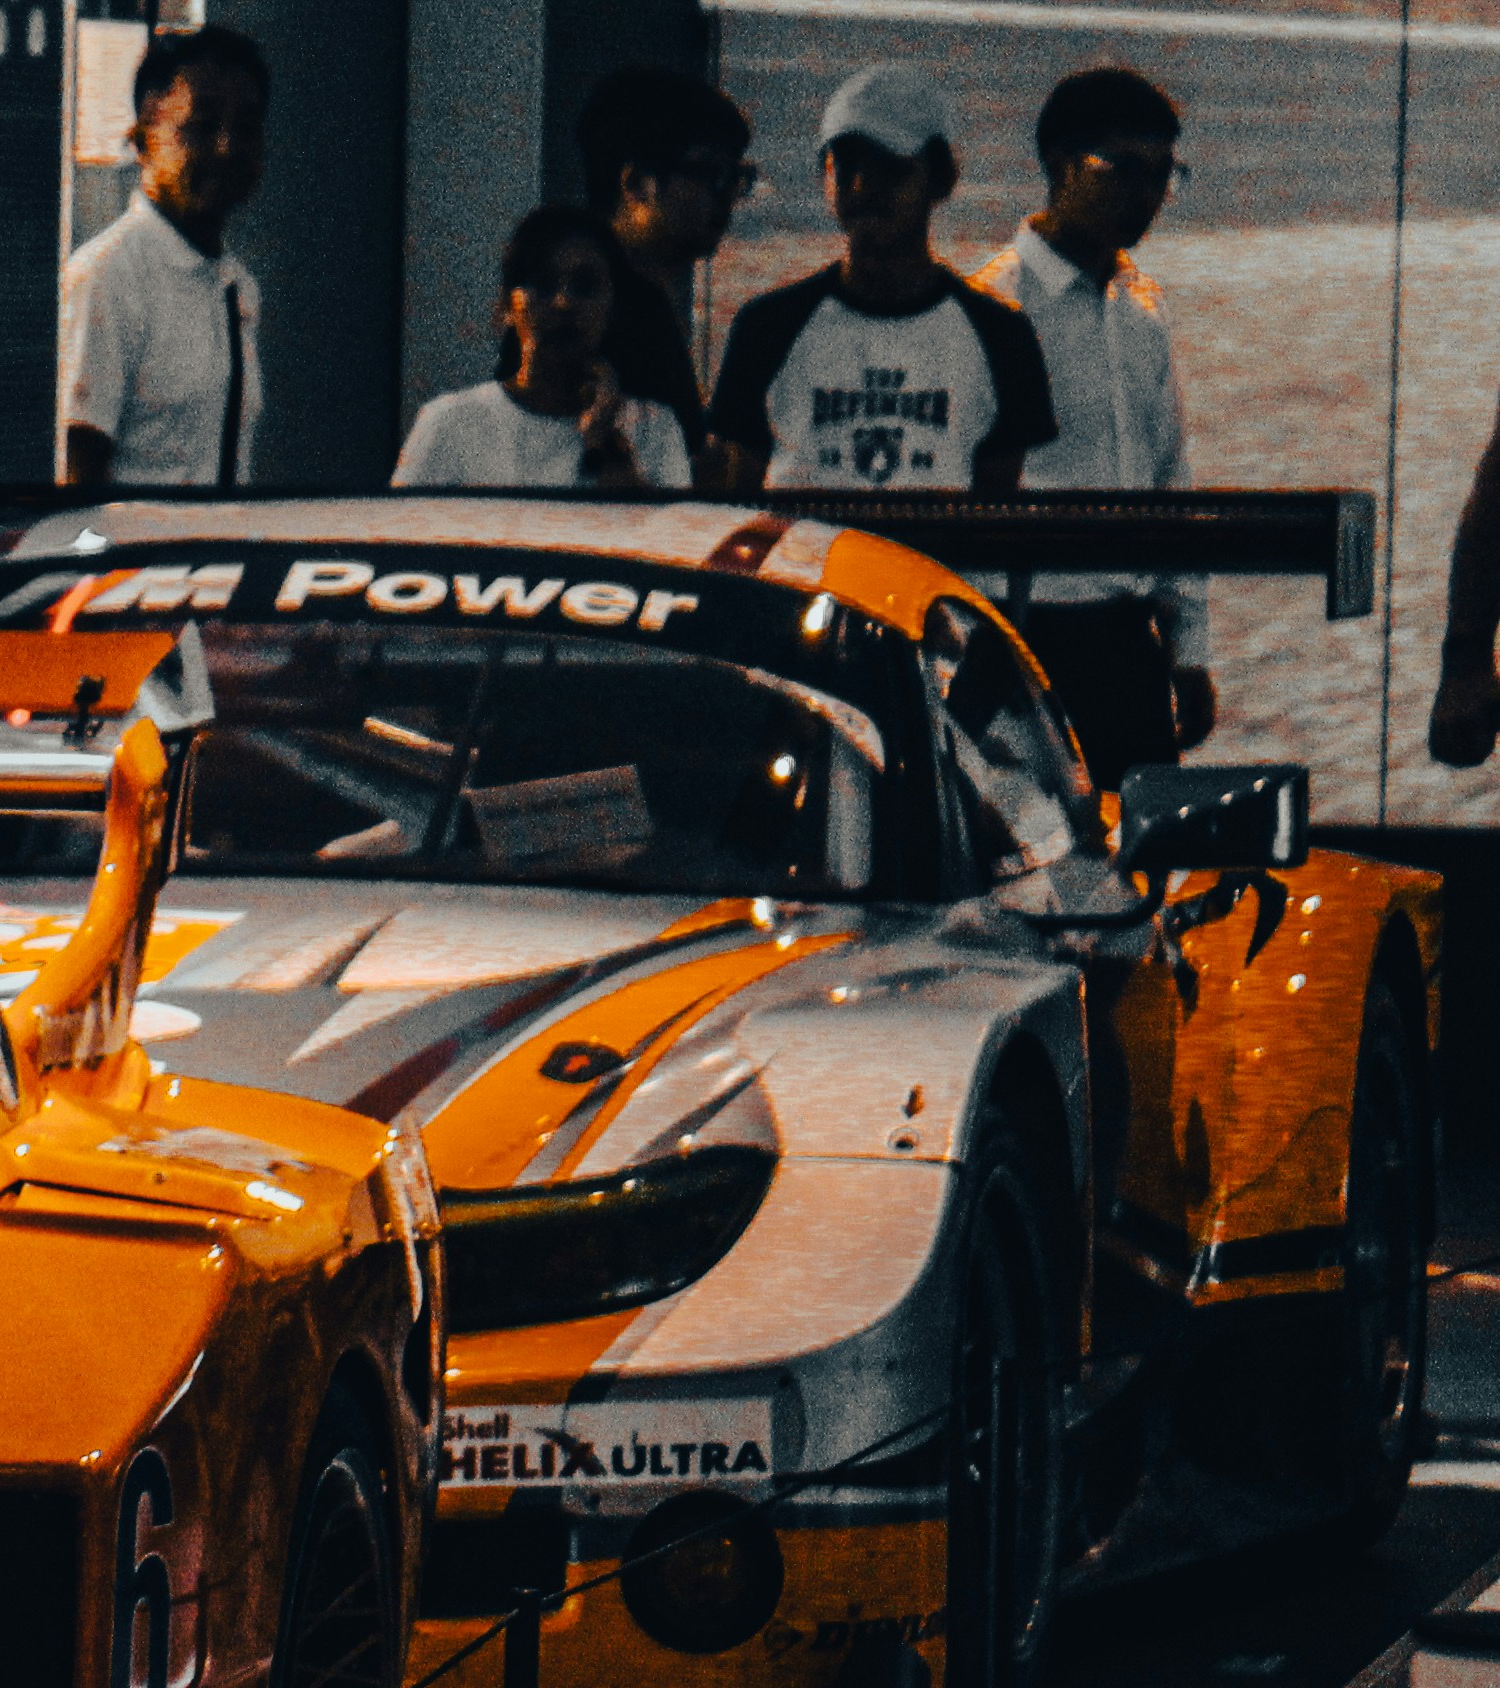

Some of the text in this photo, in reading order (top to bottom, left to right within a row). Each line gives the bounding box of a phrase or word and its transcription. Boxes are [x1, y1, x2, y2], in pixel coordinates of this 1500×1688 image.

[274, 560, 699, 632] Power
[438, 1434, 769, 1478] HELIX ULTRA
